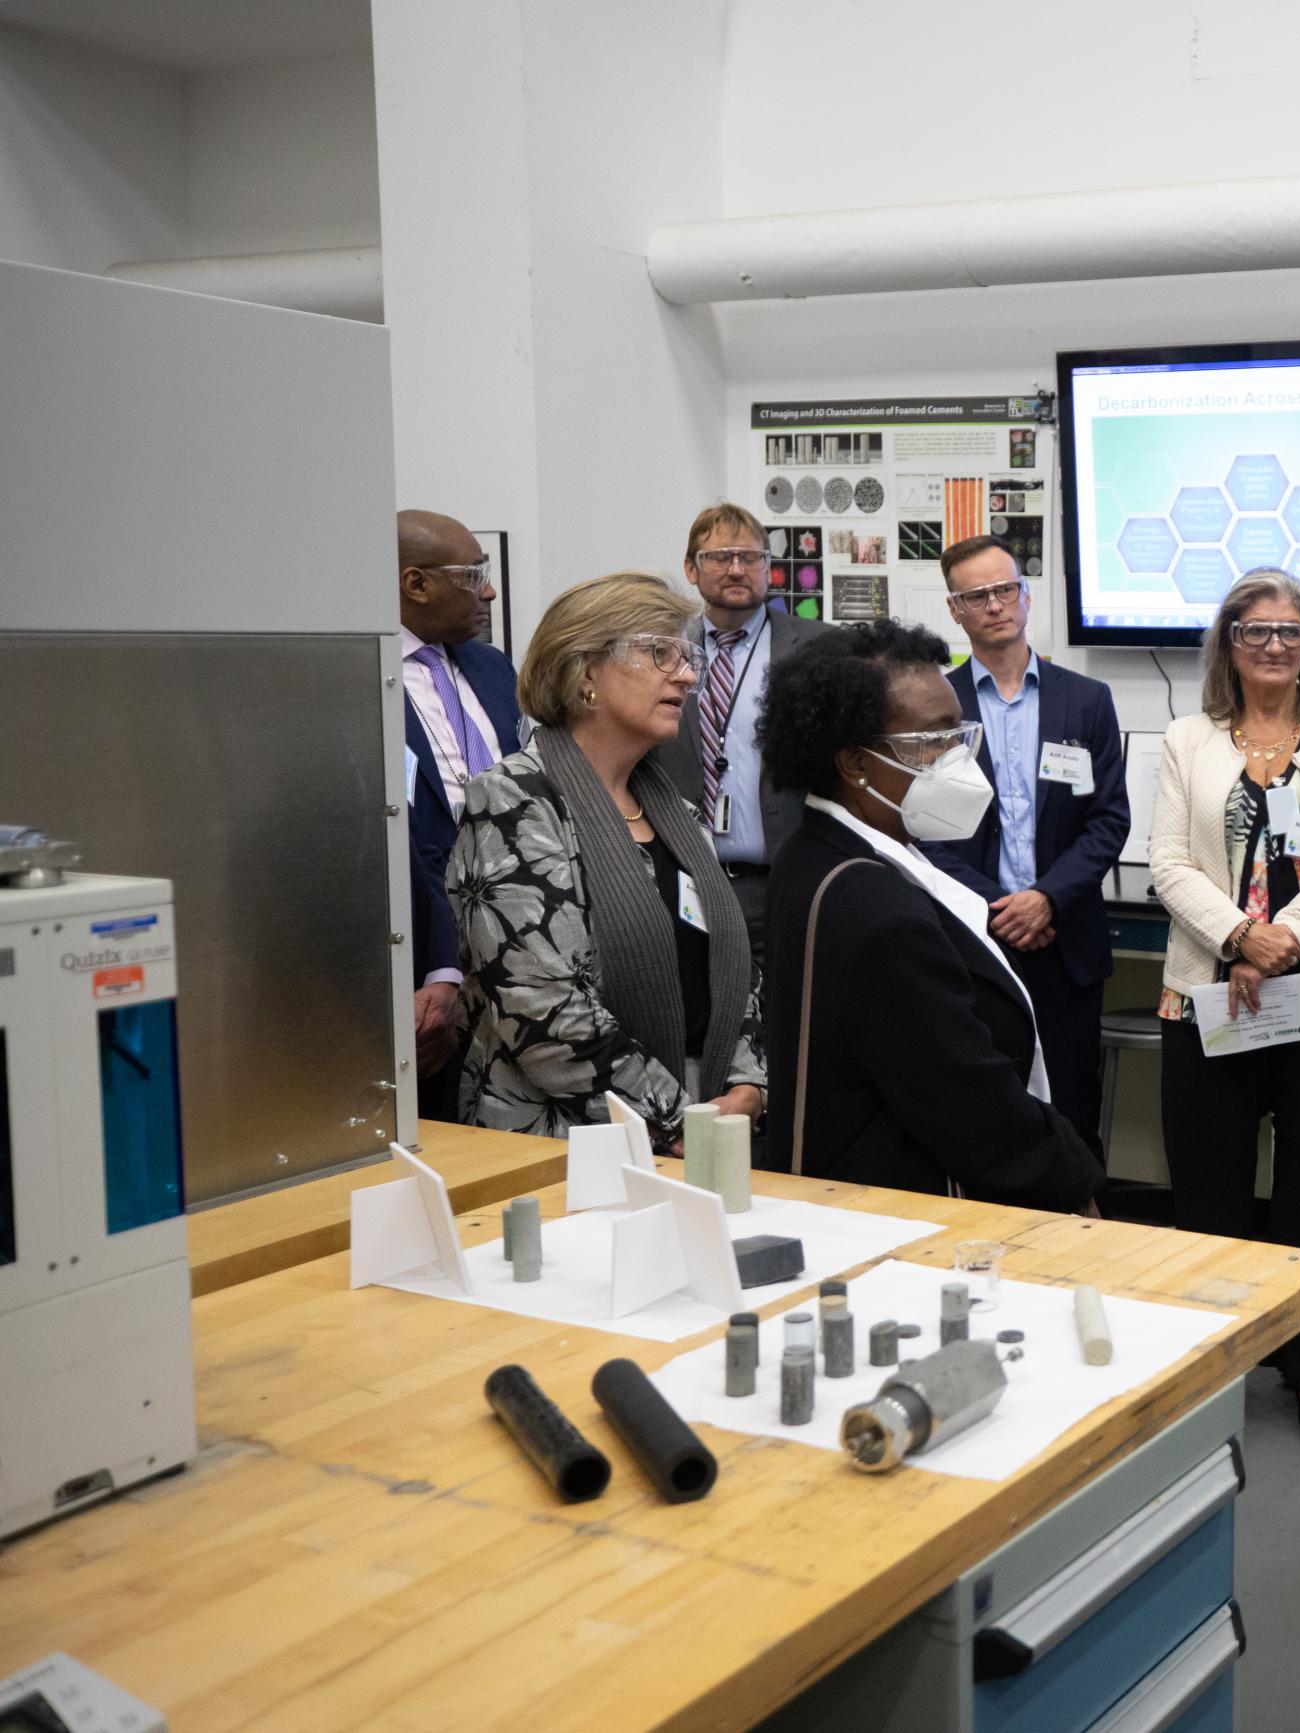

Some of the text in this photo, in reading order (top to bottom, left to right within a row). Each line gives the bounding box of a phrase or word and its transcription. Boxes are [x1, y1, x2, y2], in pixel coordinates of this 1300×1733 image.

[1098, 394, 1238, 411] Decarbonization
[760, 405, 964, 419] CT Imaging and 3D Characterization of Foamed Cements
